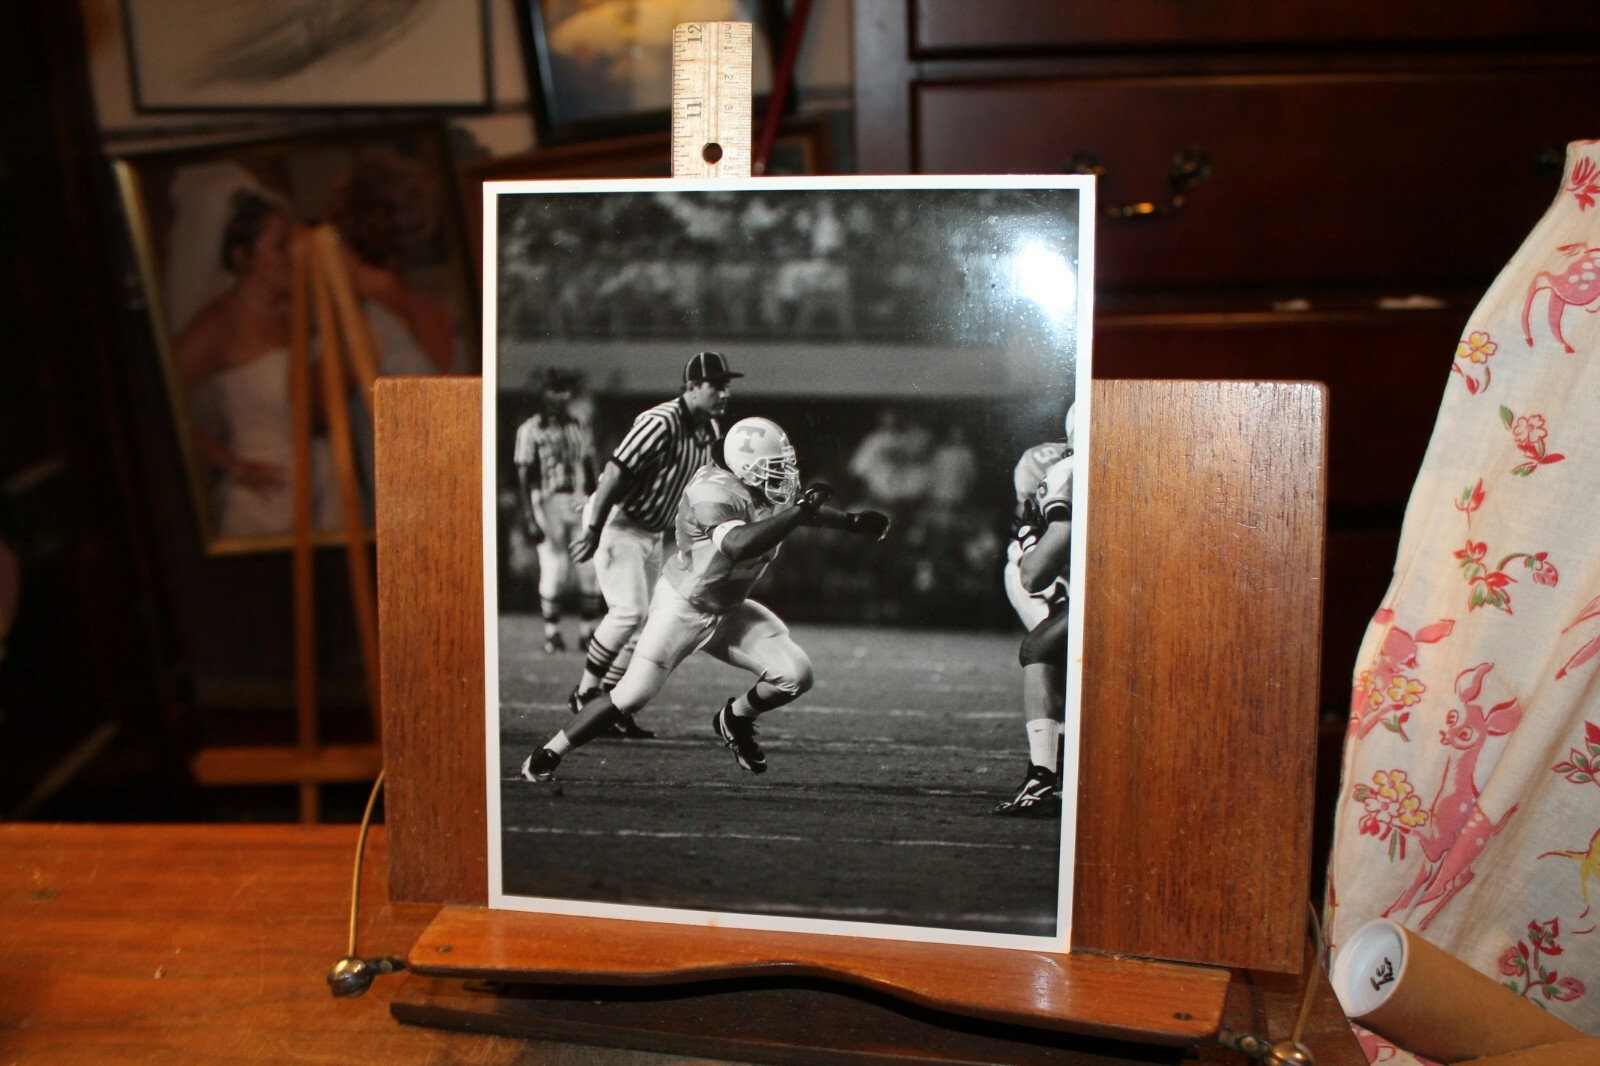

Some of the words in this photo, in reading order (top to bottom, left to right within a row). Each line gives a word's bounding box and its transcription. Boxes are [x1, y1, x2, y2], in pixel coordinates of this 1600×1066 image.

[687, 24, 702, 44] 12
[686, 101, 701, 119] 11
[736, 425, 767, 454] T
